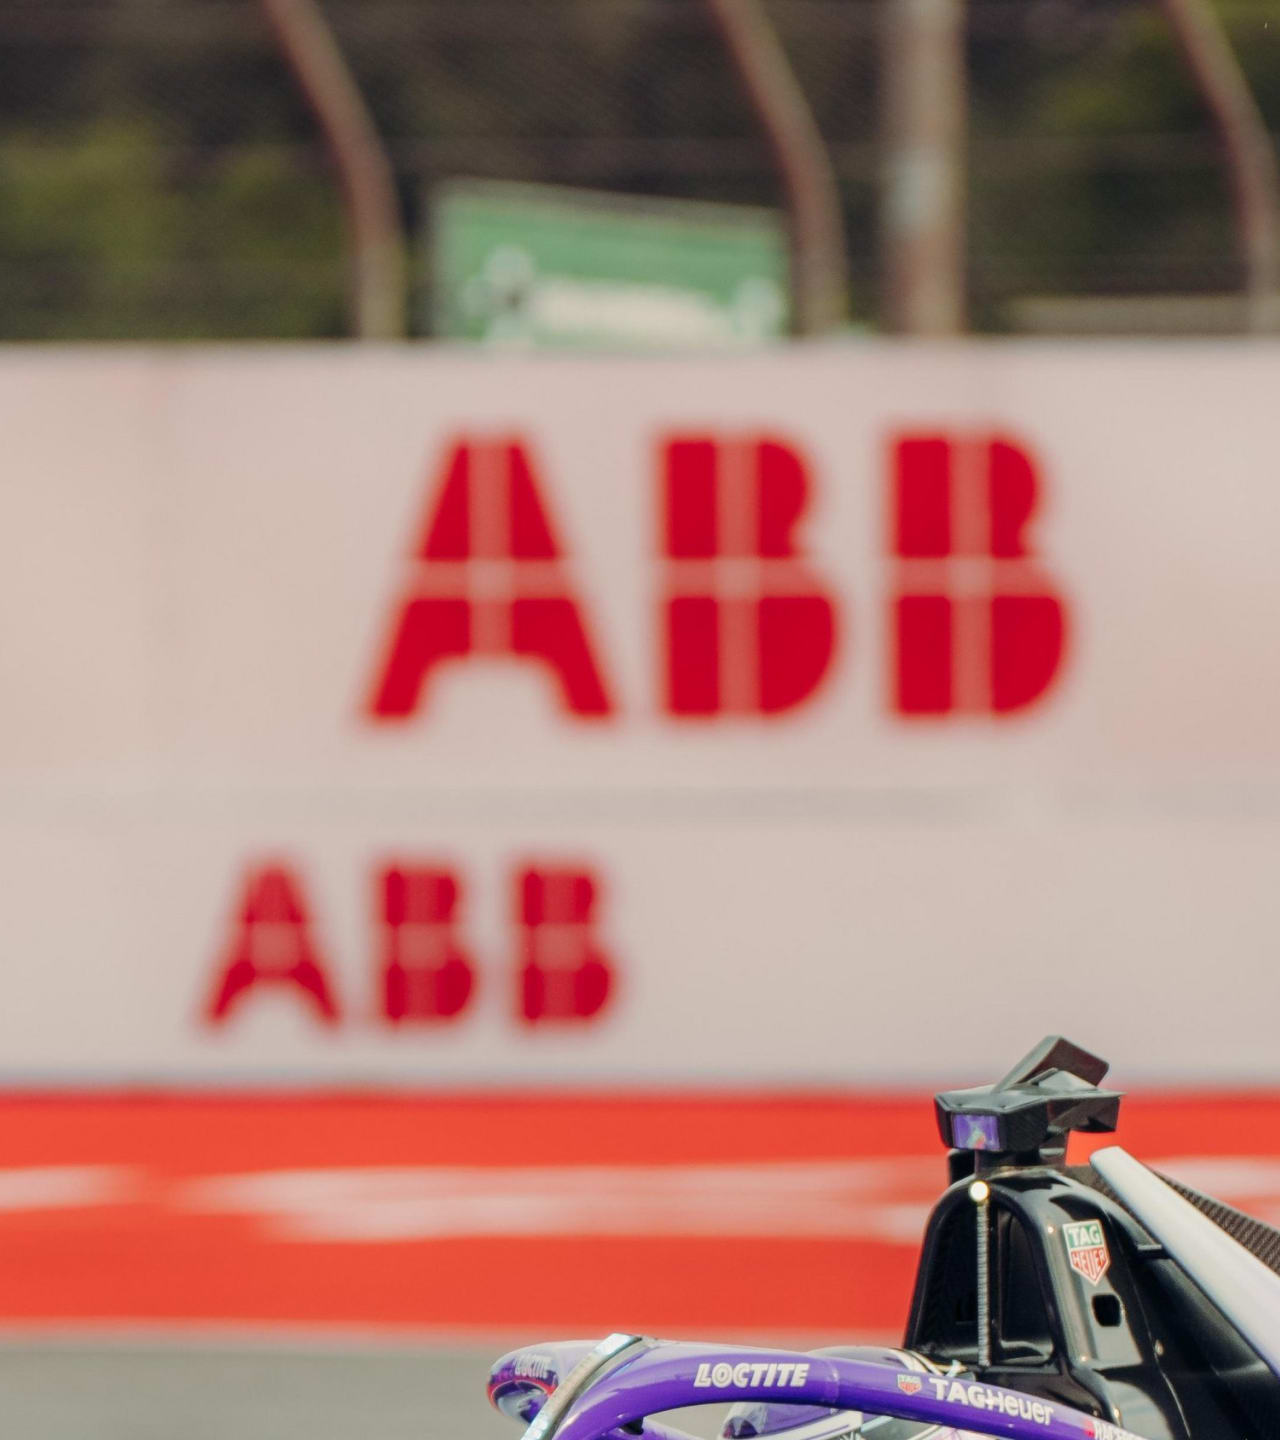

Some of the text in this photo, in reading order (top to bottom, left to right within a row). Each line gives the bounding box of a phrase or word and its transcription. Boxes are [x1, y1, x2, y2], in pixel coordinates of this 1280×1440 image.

[363, 428, 1073, 728] ABB
[204, 859, 620, 1030] ABB
[1068, 1225, 1102, 1247] TAG
[693, 1362, 811, 1389] LOCTITE
